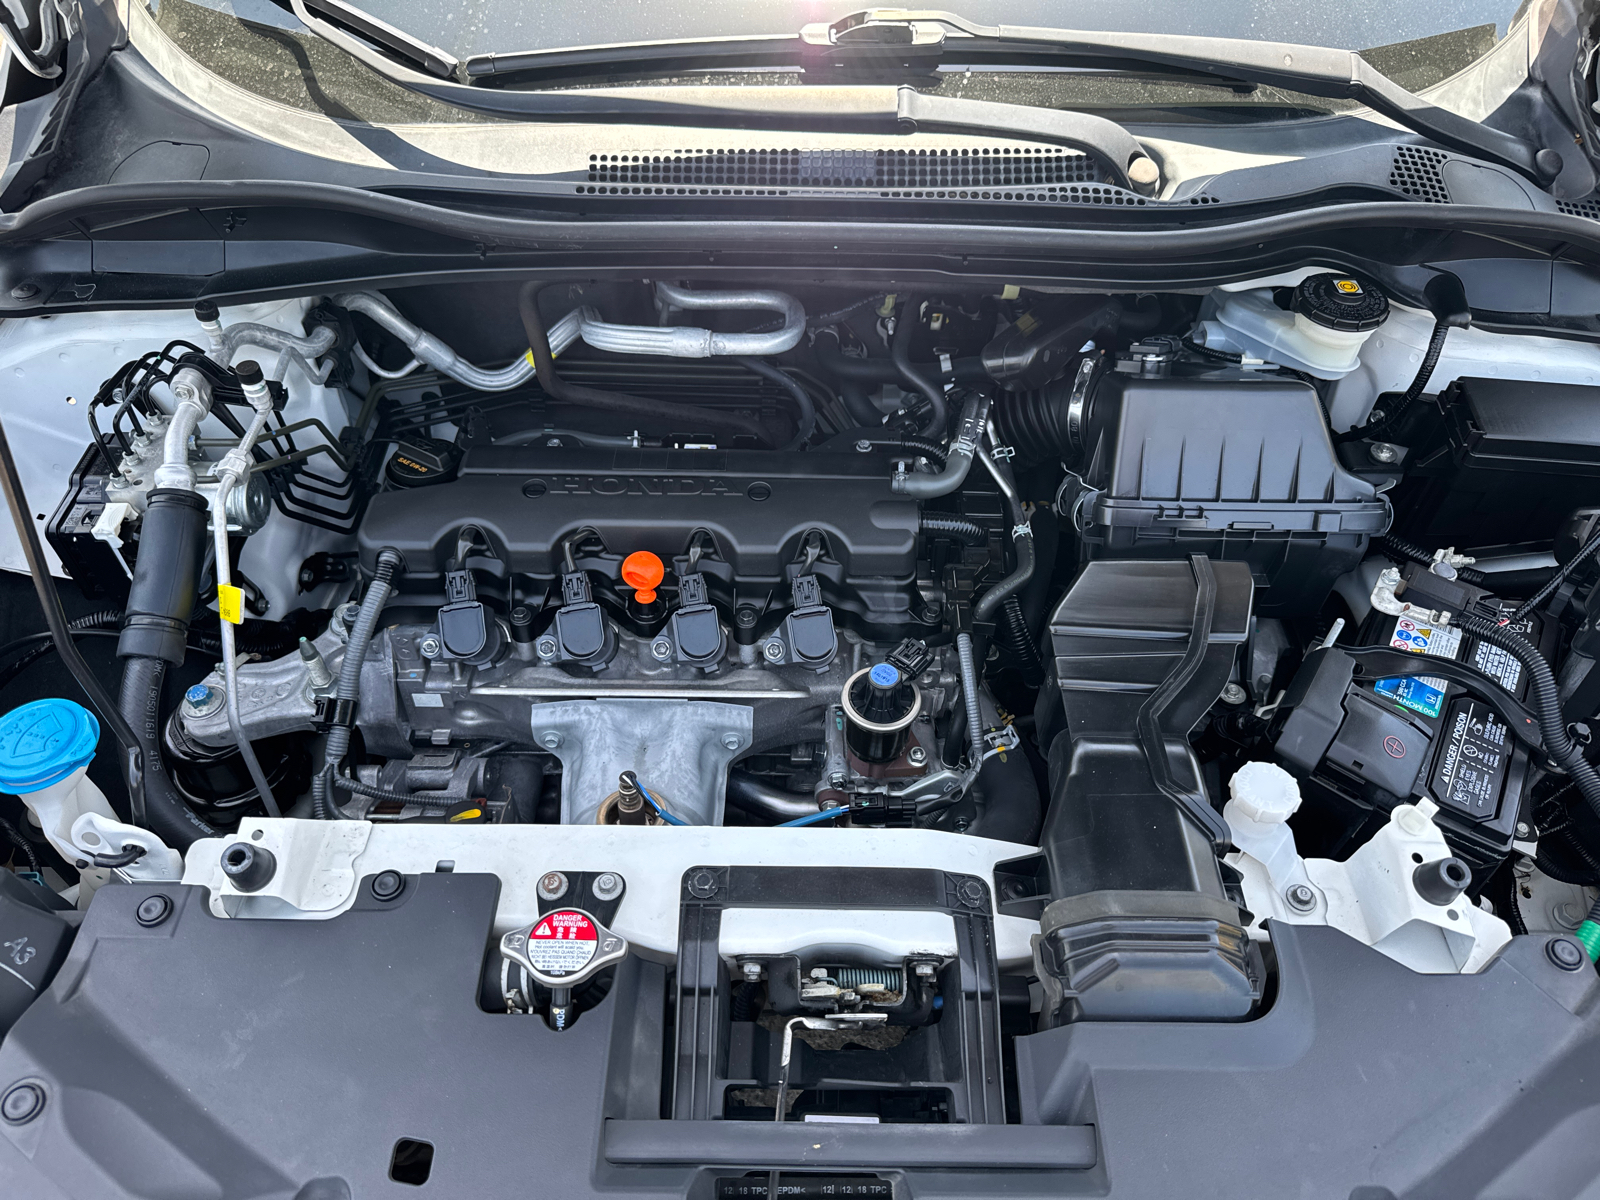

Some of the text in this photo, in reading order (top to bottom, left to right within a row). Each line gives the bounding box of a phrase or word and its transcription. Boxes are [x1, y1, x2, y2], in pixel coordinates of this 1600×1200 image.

[397, 457, 411, 466] SAE
[550, 477, 744, 496] HONDA
[1393, 695, 1435, 716] 100 MONTH
[1443, 744, 1458, 775] DANGER
[1453, 712, 1467, 739] POISON
[150, 750, 162, 771] 4175
[186, 812, 214, 835] Parker
[552, 920, 588, 928] WARNUNG
[4, 936, 37, 966] A3
[858, 1186, 867, 1194] 18
[870, 1186, 887, 1194] TPC
